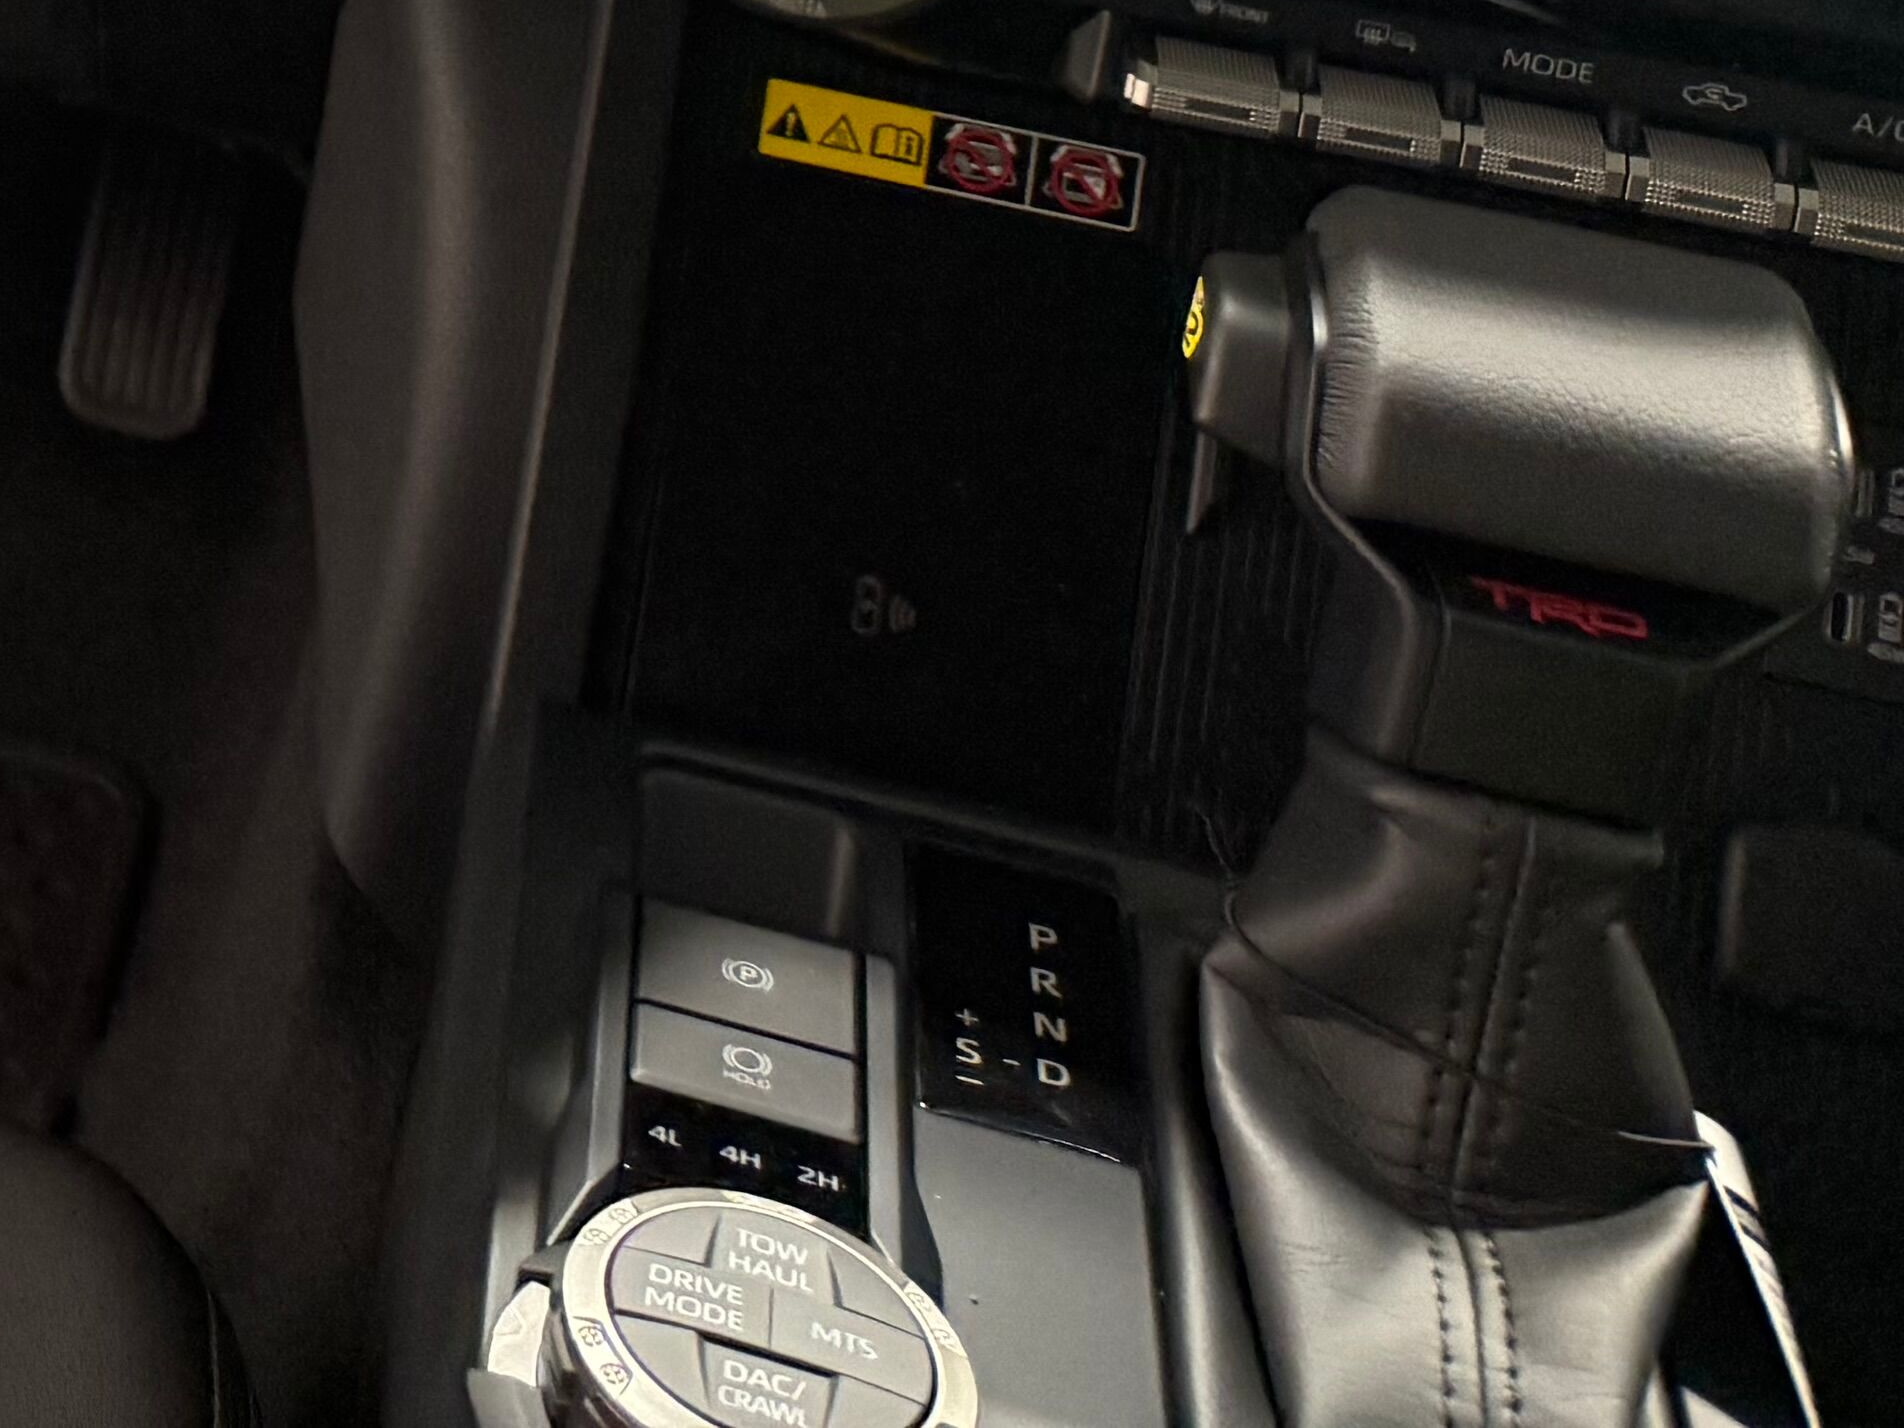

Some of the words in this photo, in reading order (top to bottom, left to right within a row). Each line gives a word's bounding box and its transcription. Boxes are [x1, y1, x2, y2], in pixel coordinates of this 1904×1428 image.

[1502, 48, 1593, 84] MODE
[1470, 574, 1648, 640] TRD
[1029, 922, 1058, 951] P
[1029, 966, 1063, 999] R
[1033, 1011, 1067, 1043] N
[955, 1036, 984, 1064] S
[723, 1069, 772, 1090] HOLD
[1036, 1058, 1071, 1087] D
[648, 1125, 682, 1147] 4L
[719, 1145, 761, 1170] 4H
[797, 1165, 839, 1191] 2H
[737, 1228, 808, 1265] TOW
[648, 1263, 743, 1306] DRIVE
[728, 1251, 814, 1293] HAUL
[645, 1287, 743, 1331] MODE
[810, 1321, 878, 1360] MTS
[723, 1359, 807, 1400] DAC/
[718, 1385, 808, 1428] CRAWL
